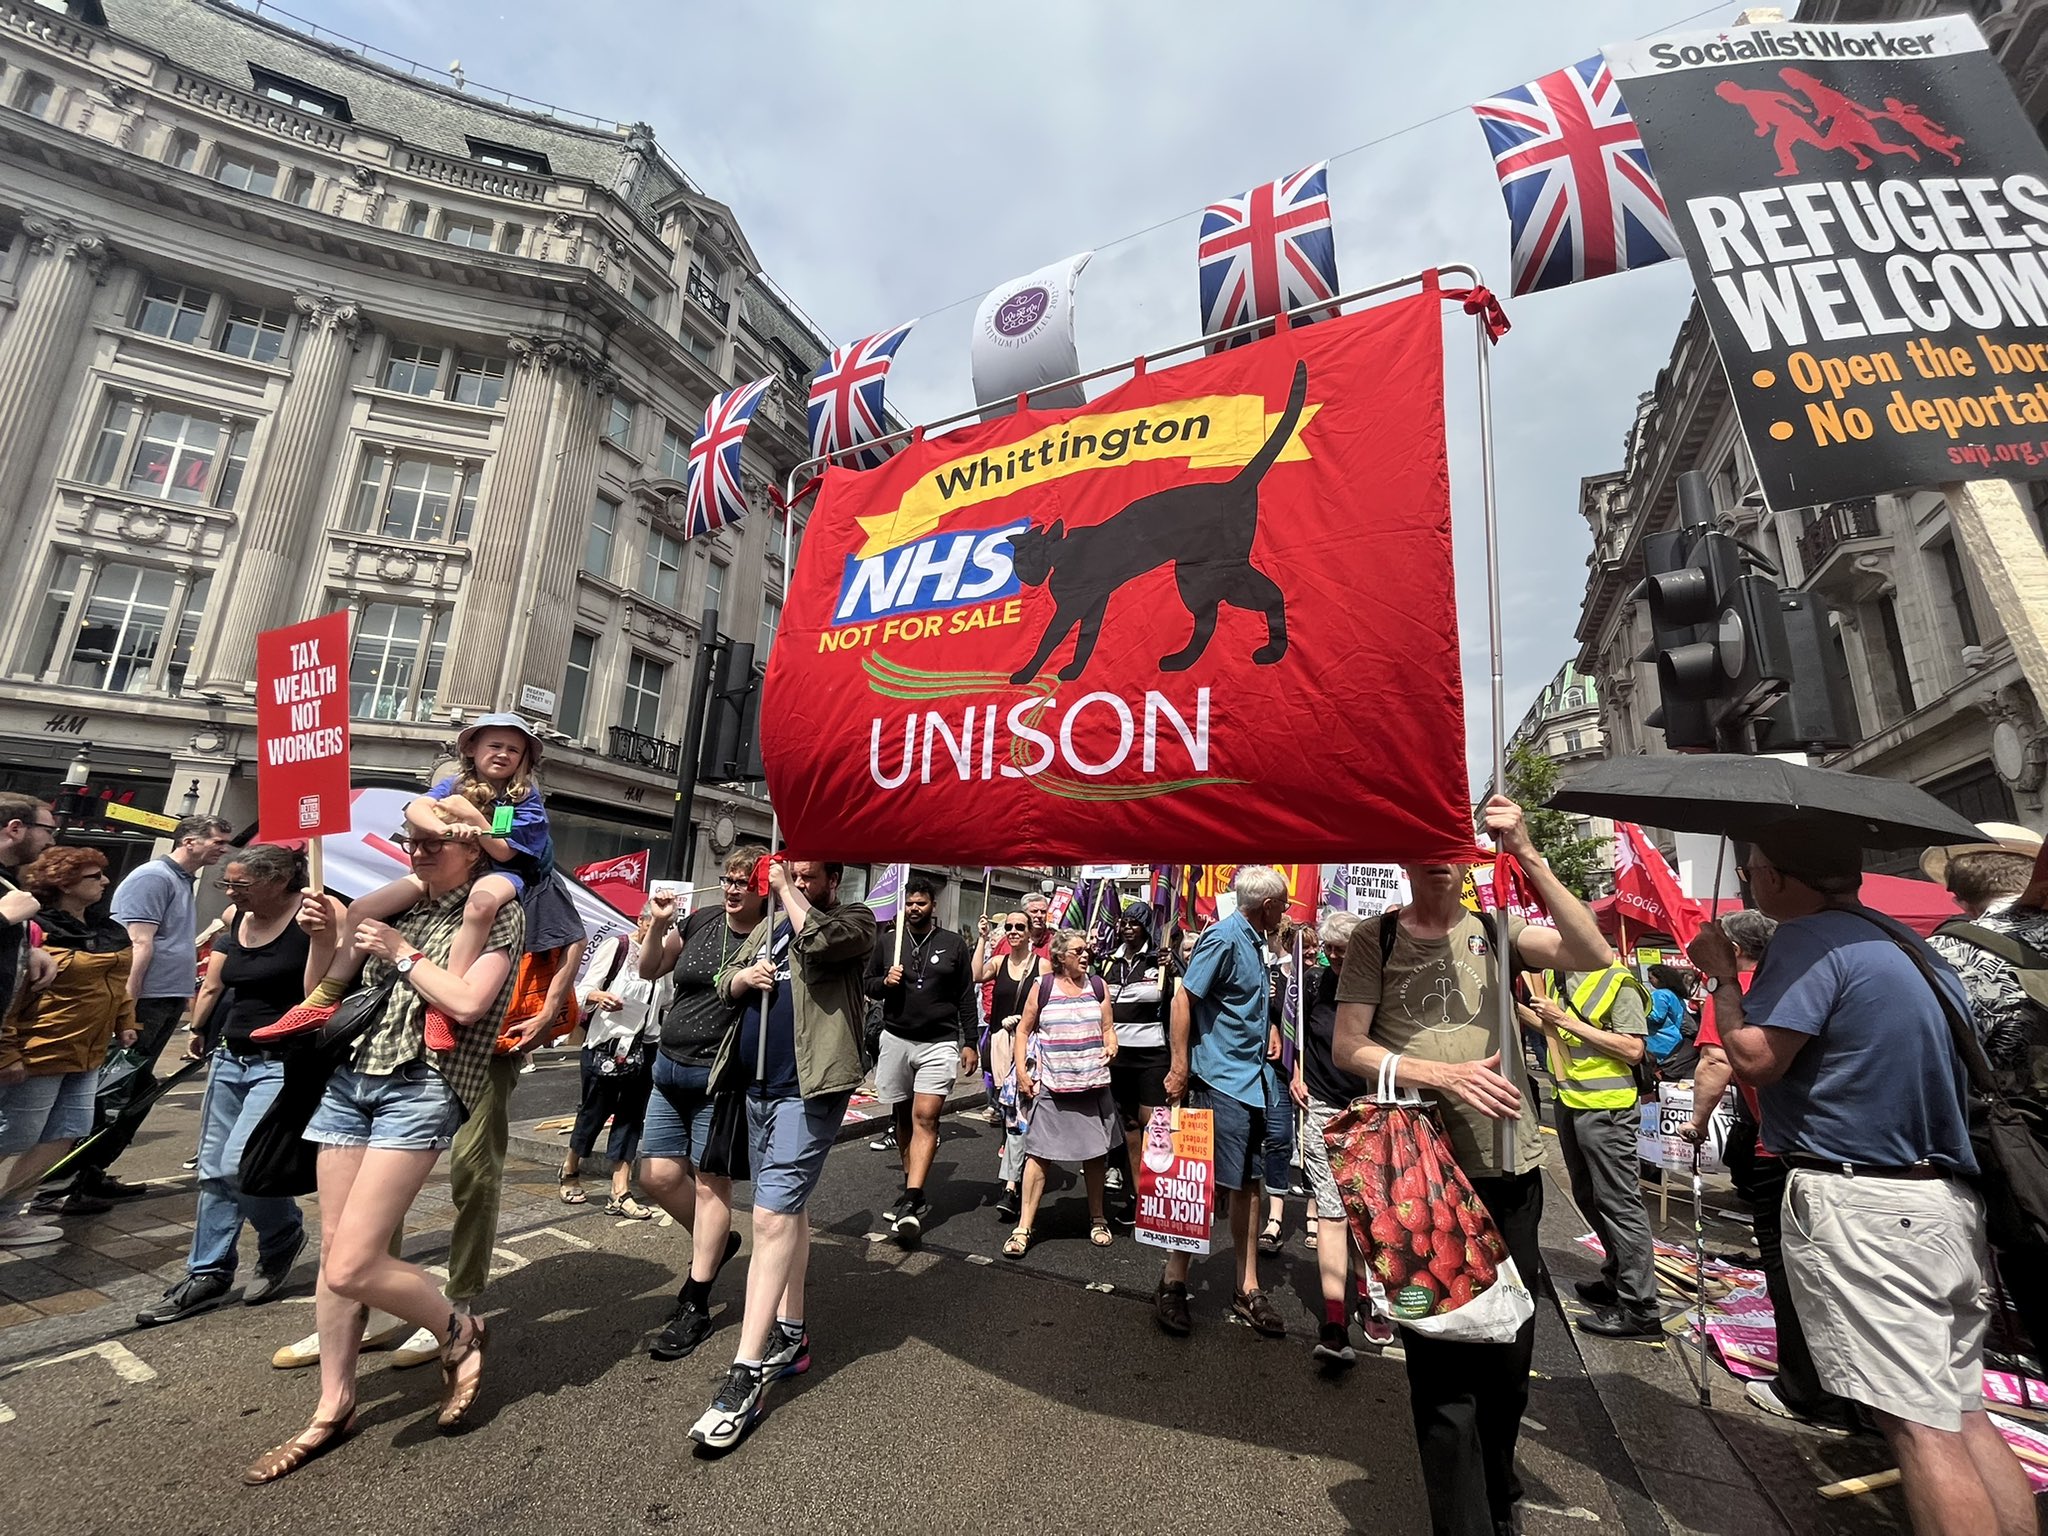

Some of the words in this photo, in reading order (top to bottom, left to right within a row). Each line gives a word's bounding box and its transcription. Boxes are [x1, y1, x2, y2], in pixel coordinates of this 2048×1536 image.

[1686, 174, 2048, 273] REFUGEES
[1786, 351, 1903, 399] Open
[1905, 337, 1977, 379] the
[1976, 335, 2048, 375] bor
[1804, 400, 1874, 447] No
[934, 413, 1211, 501] Whittington
[835, 525, 1028, 620] NHS
[817, 623, 879, 653] NOT
[882, 614, 944, 644] FOR
[948, 599, 1022, 635] SALE
[290, 638, 321, 672] TAX
[273, 664, 337, 705] WEALTH
[43, 714, 89, 735] H&M
[290, 699, 322, 732] NOT
[267, 725, 344, 766] WORKERS
[868, 685, 1213, 791] UNISON
[1347, 876, 1379, 888] DOESN'T
[1380, 879, 1399, 890] RISE
[1352, 866, 1360, 875] IF
[1361, 866, 1377, 877] OUR
[1378, 868, 1394, 879] PAY
[1355, 887, 1367, 897] WE
[1368, 888, 1387, 899] WILL
[1357, 908, 1367, 916] WE
[1437, 958, 1447, 971] 3
[1187, 1119, 1208, 1131] Strike
[1661, 1109, 1694, 1122] TORI
[1182, 1133, 1208, 1145] protest
[1186, 1144, 1208, 1156] Strike
[1177, 1159, 1207, 1182] OUT
[1154, 1176, 1206, 1203] TORIES
[1140, 1195, 1166, 1219] THE
[1170, 1199, 1205, 1225] KICK
